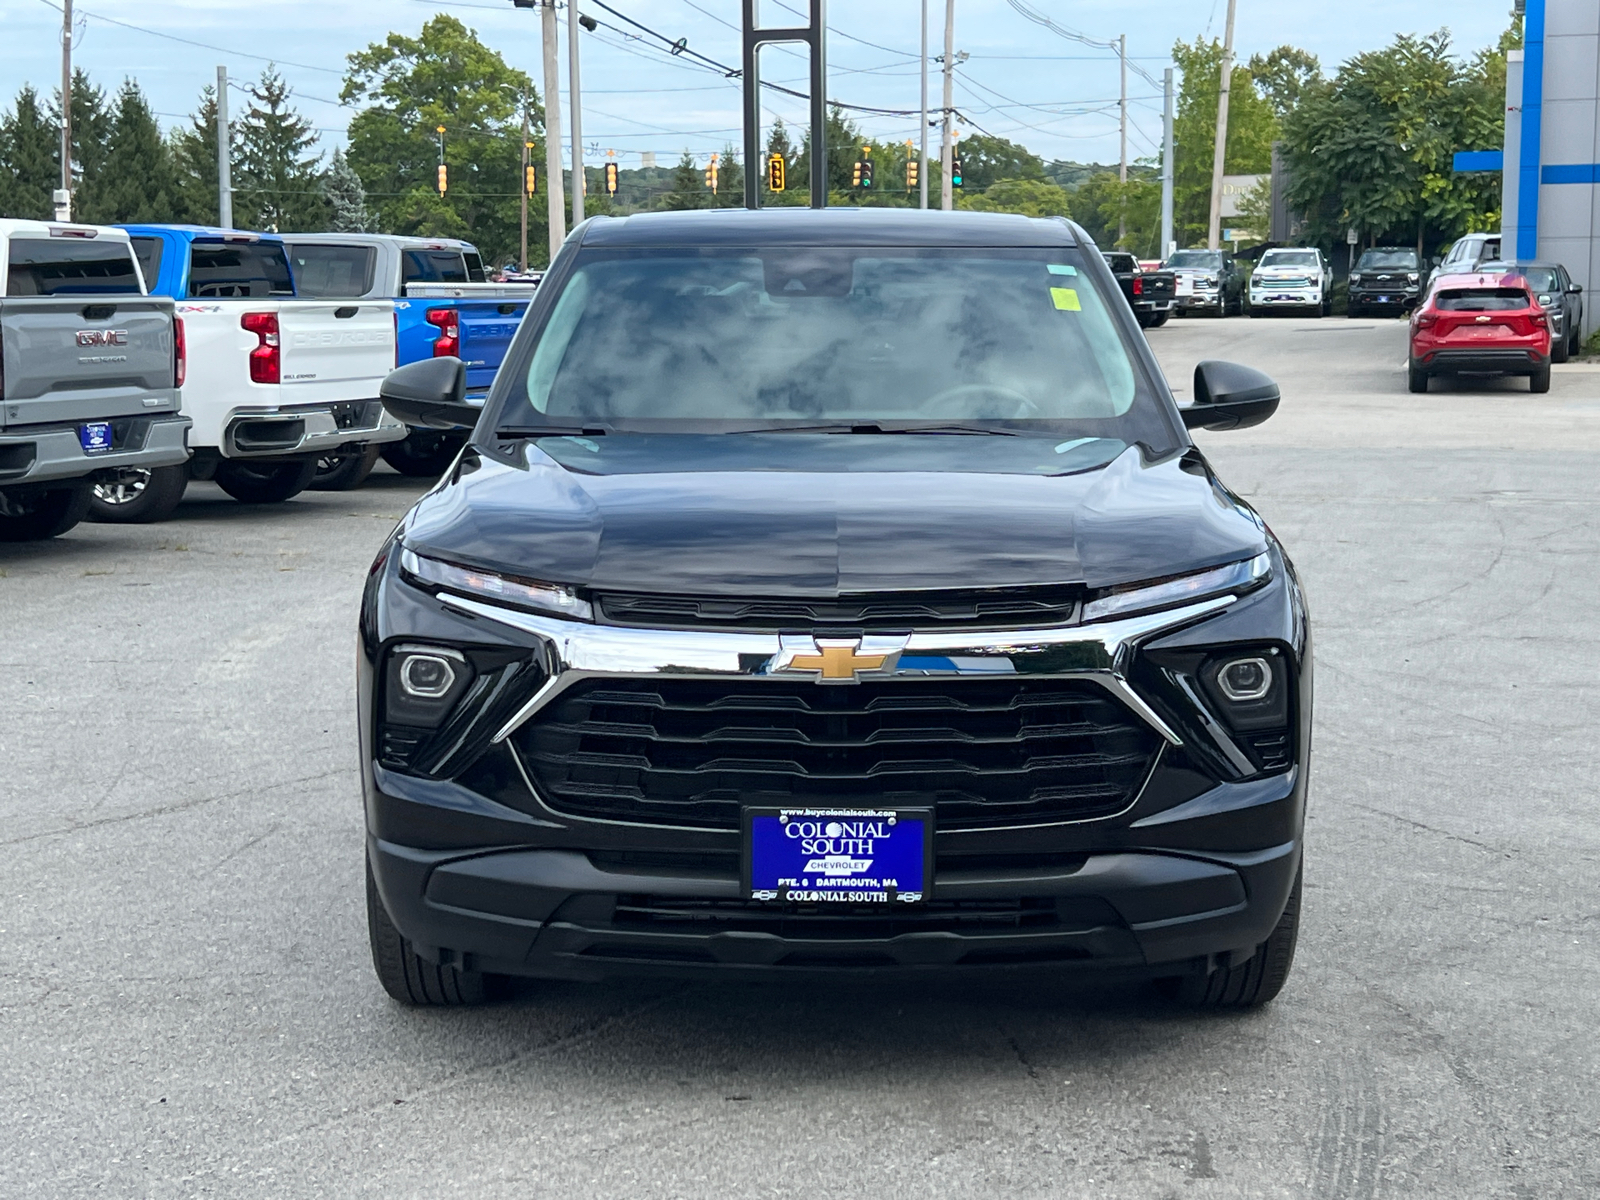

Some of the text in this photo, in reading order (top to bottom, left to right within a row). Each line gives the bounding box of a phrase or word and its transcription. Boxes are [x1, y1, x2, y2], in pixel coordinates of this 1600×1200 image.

[76, 329, 128, 347] GMC
[292, 331, 392, 346] CHEVROLET
[780, 808, 897, 818] www.buycolonialsouth.com
[785, 822, 891, 839] COLONIAL
[801, 839, 874, 855] SOUTH
[810, 861, 866, 870] CHEVROLET
[802, 878, 809, 887] 6
[816, 878, 881, 888] DARTMOUTH,
[786, 890, 888, 902] COLONIAL SOUTH
